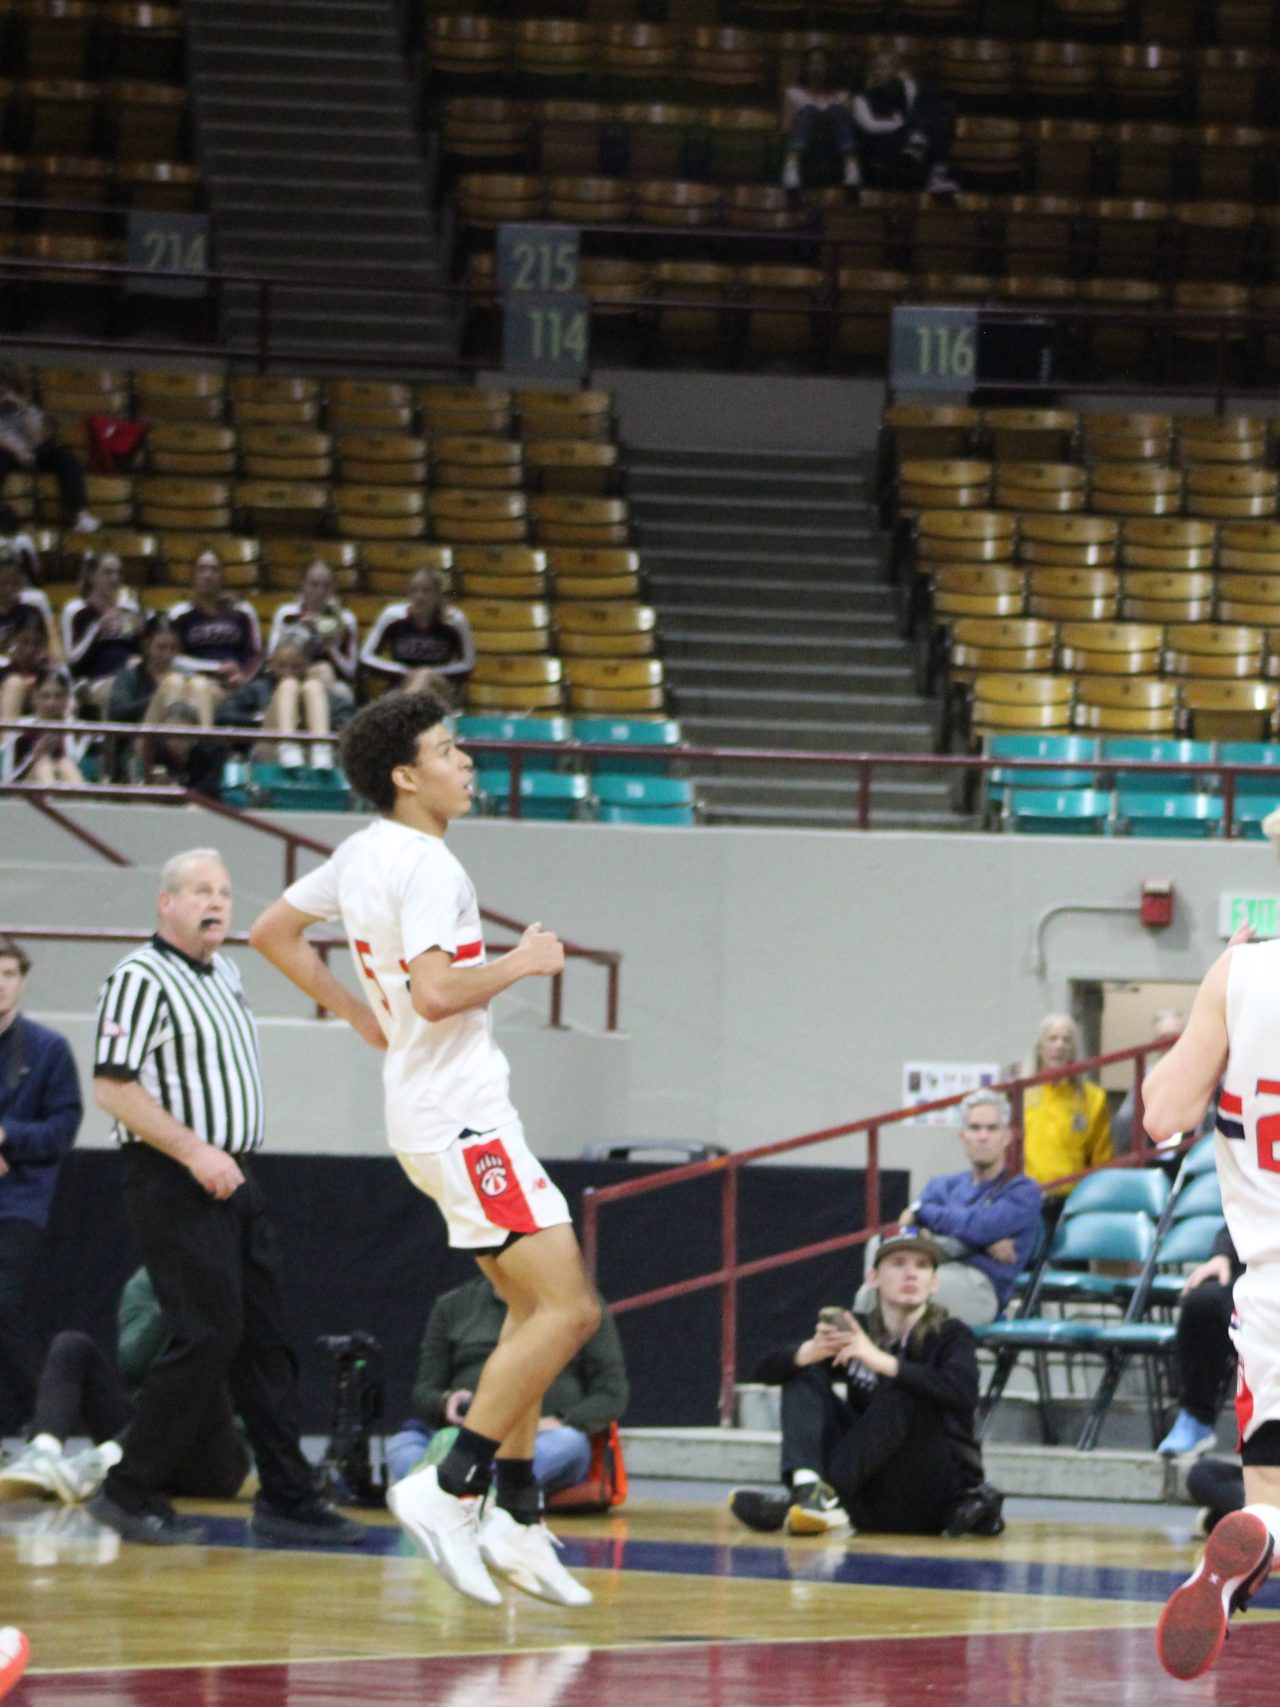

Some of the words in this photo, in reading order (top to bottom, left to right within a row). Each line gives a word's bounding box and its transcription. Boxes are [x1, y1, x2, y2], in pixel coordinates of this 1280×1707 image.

[143, 230, 206, 272] 214
[513, 243, 577, 292] 215
[530, 311, 587, 361] 114
[918, 326, 975, 377] 116
[1231, 896, 1277, 933] EXIT
